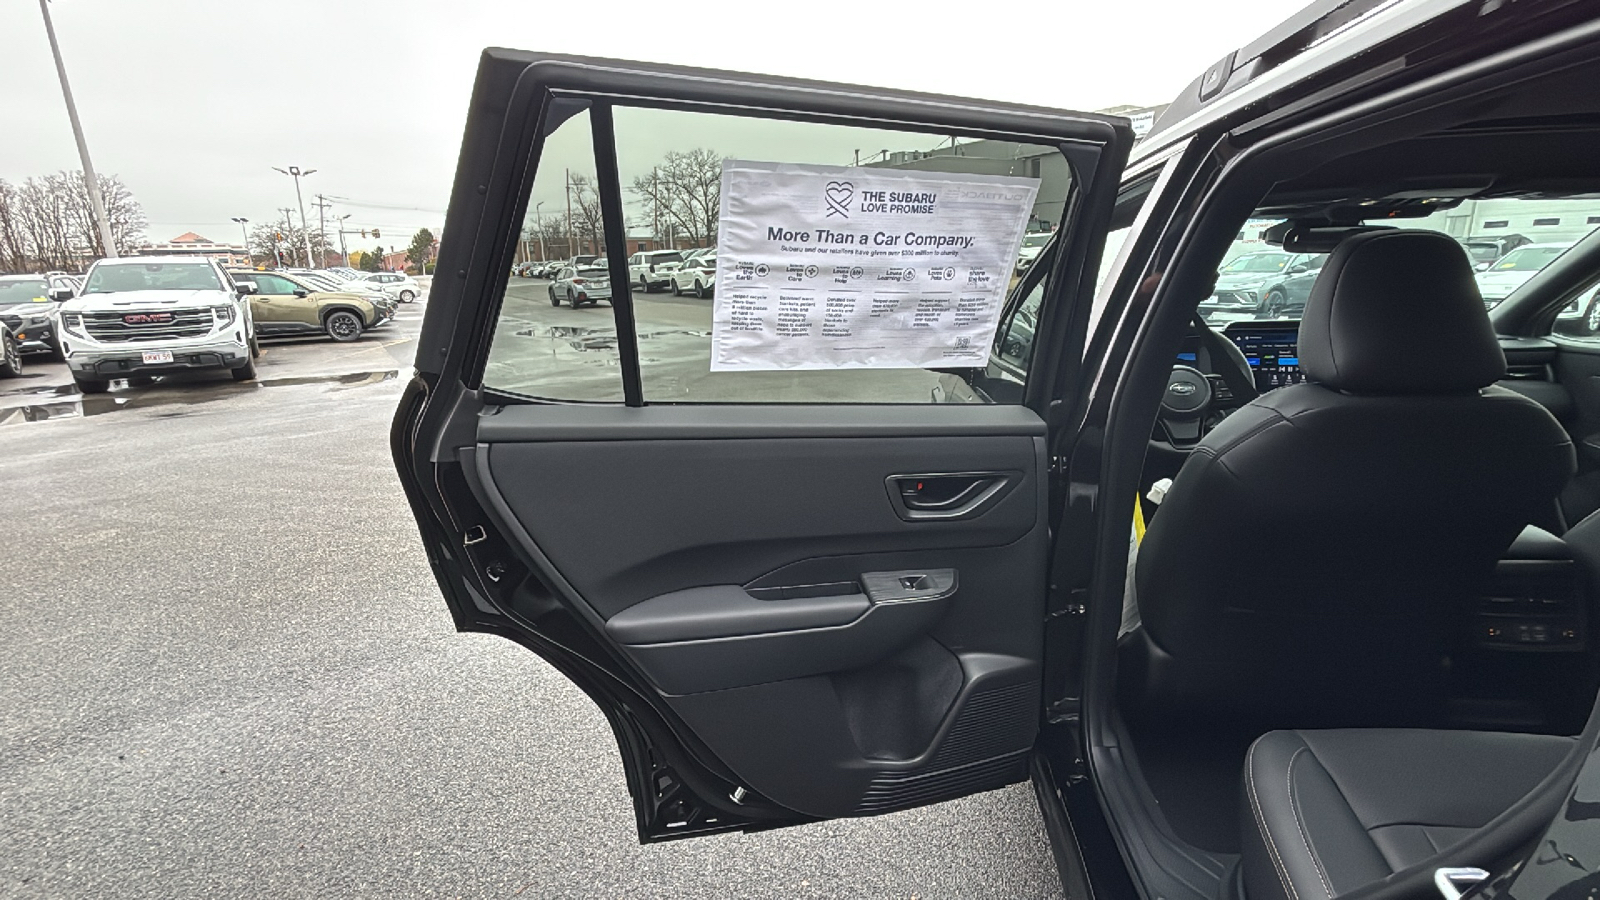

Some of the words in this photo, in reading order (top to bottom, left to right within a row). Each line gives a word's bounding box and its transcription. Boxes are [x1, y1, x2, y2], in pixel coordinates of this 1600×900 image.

[862, 191, 886, 202] THE
[889, 192, 936, 203] SUBARU
[861, 204, 887, 213] LOVE
[889, 204, 935, 214] PROMISE
[767, 227, 810, 242] More
[815, 230, 854, 244] Than
[859, 233, 868, 245] a
[873, 232, 900, 245] Car
[125, 313, 172, 323] GMC
